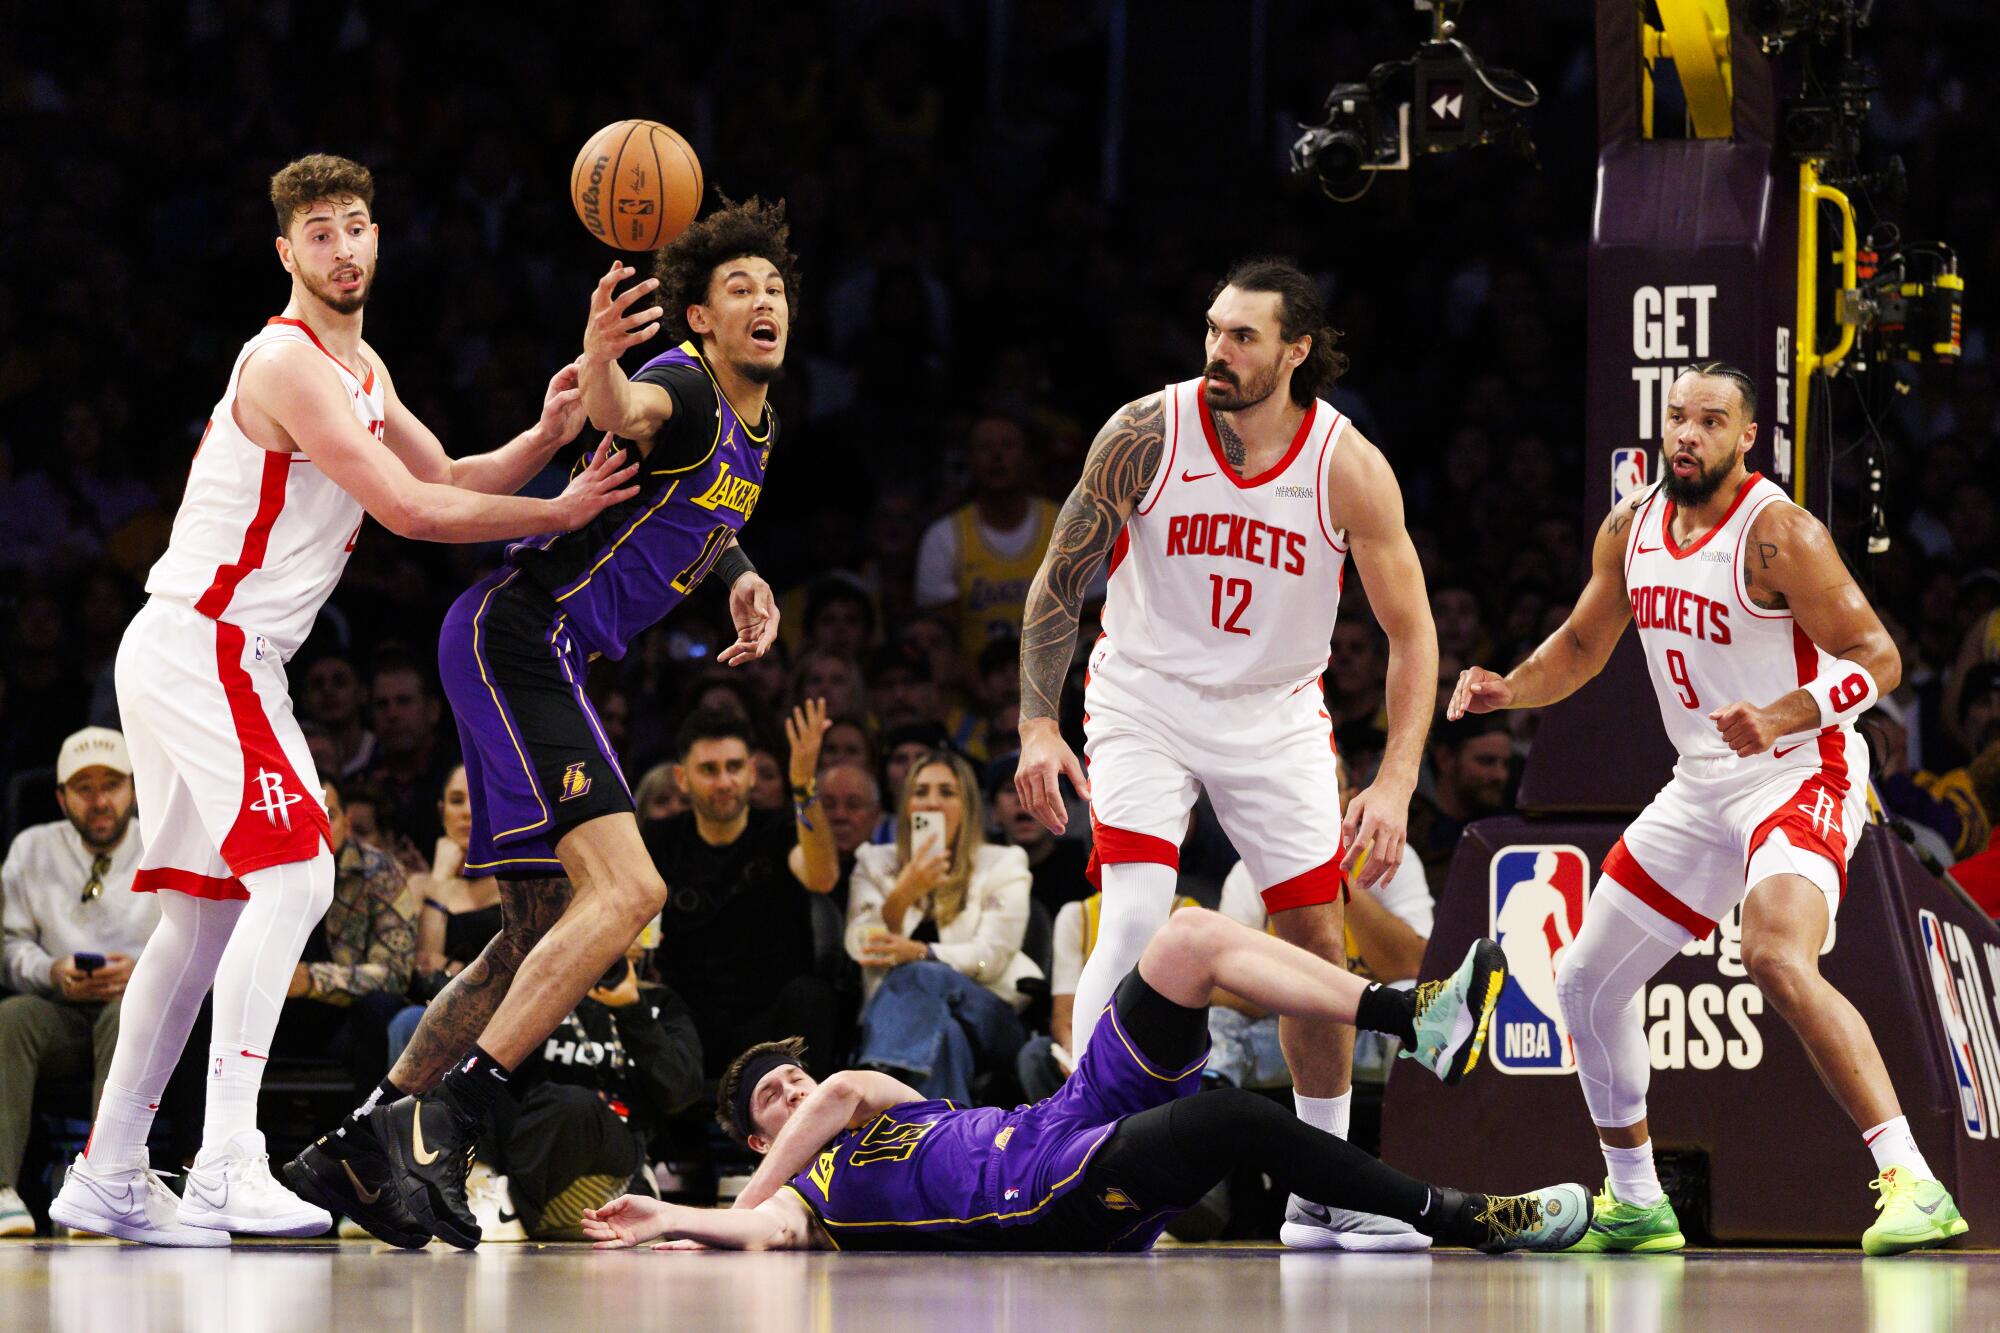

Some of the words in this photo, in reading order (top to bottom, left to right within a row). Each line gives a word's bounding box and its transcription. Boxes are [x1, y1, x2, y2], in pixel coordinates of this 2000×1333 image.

[582, 155, 611, 237] Wilson
[1632, 284, 1717, 361] GET
[1275, 485, 1314, 495] MEMORIAL
[1275, 490, 1314, 499] HERMANN
[1166, 513, 1307, 577] ROCKETS
[1209, 573, 1253, 637] 12
[1630, 585, 1732, 645] ROCKETS
[1666, 648, 1700, 710] 9
[1828, 672, 1869, 714] 9
[1504, 1022, 1552, 1058] NBA
[1637, 983, 1763, 1070] ass
[848, 1113, 939, 1167] 15
